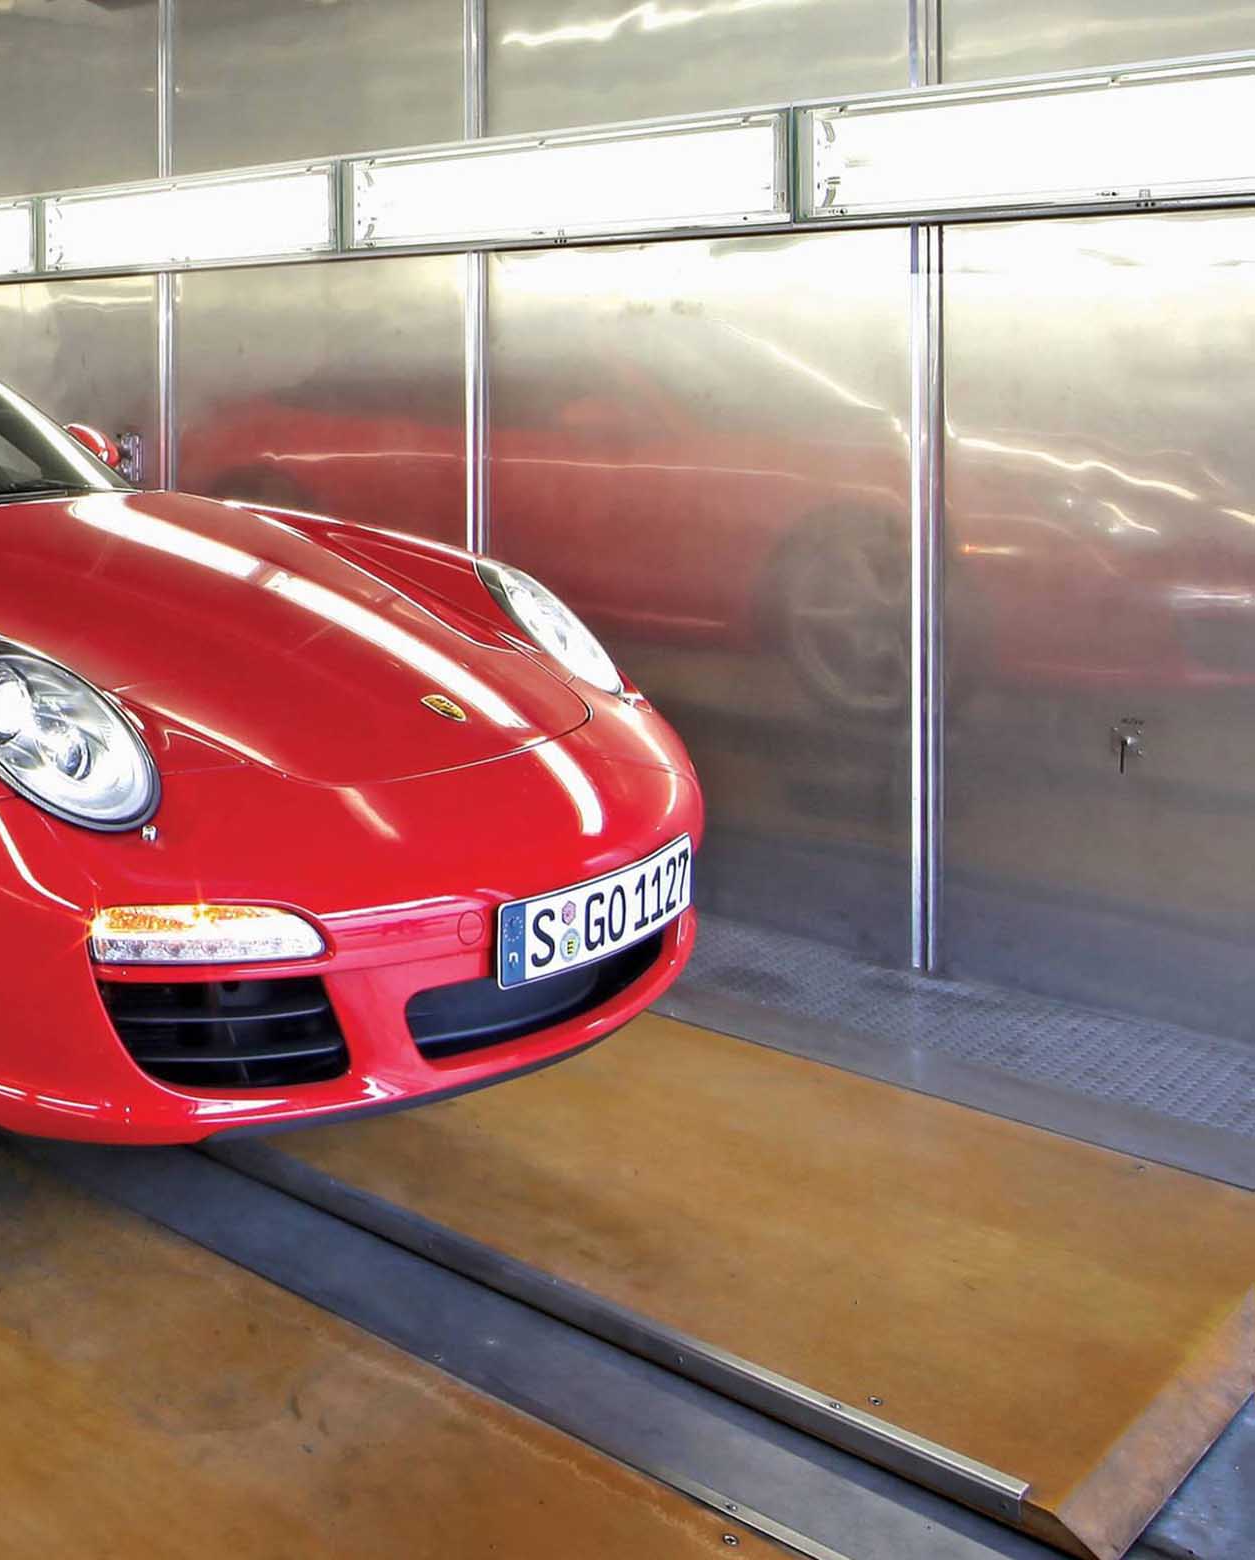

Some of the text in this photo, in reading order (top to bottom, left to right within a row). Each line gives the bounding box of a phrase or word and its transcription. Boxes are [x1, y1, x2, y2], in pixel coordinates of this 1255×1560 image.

[531, 848, 690, 968] S GO 1127
